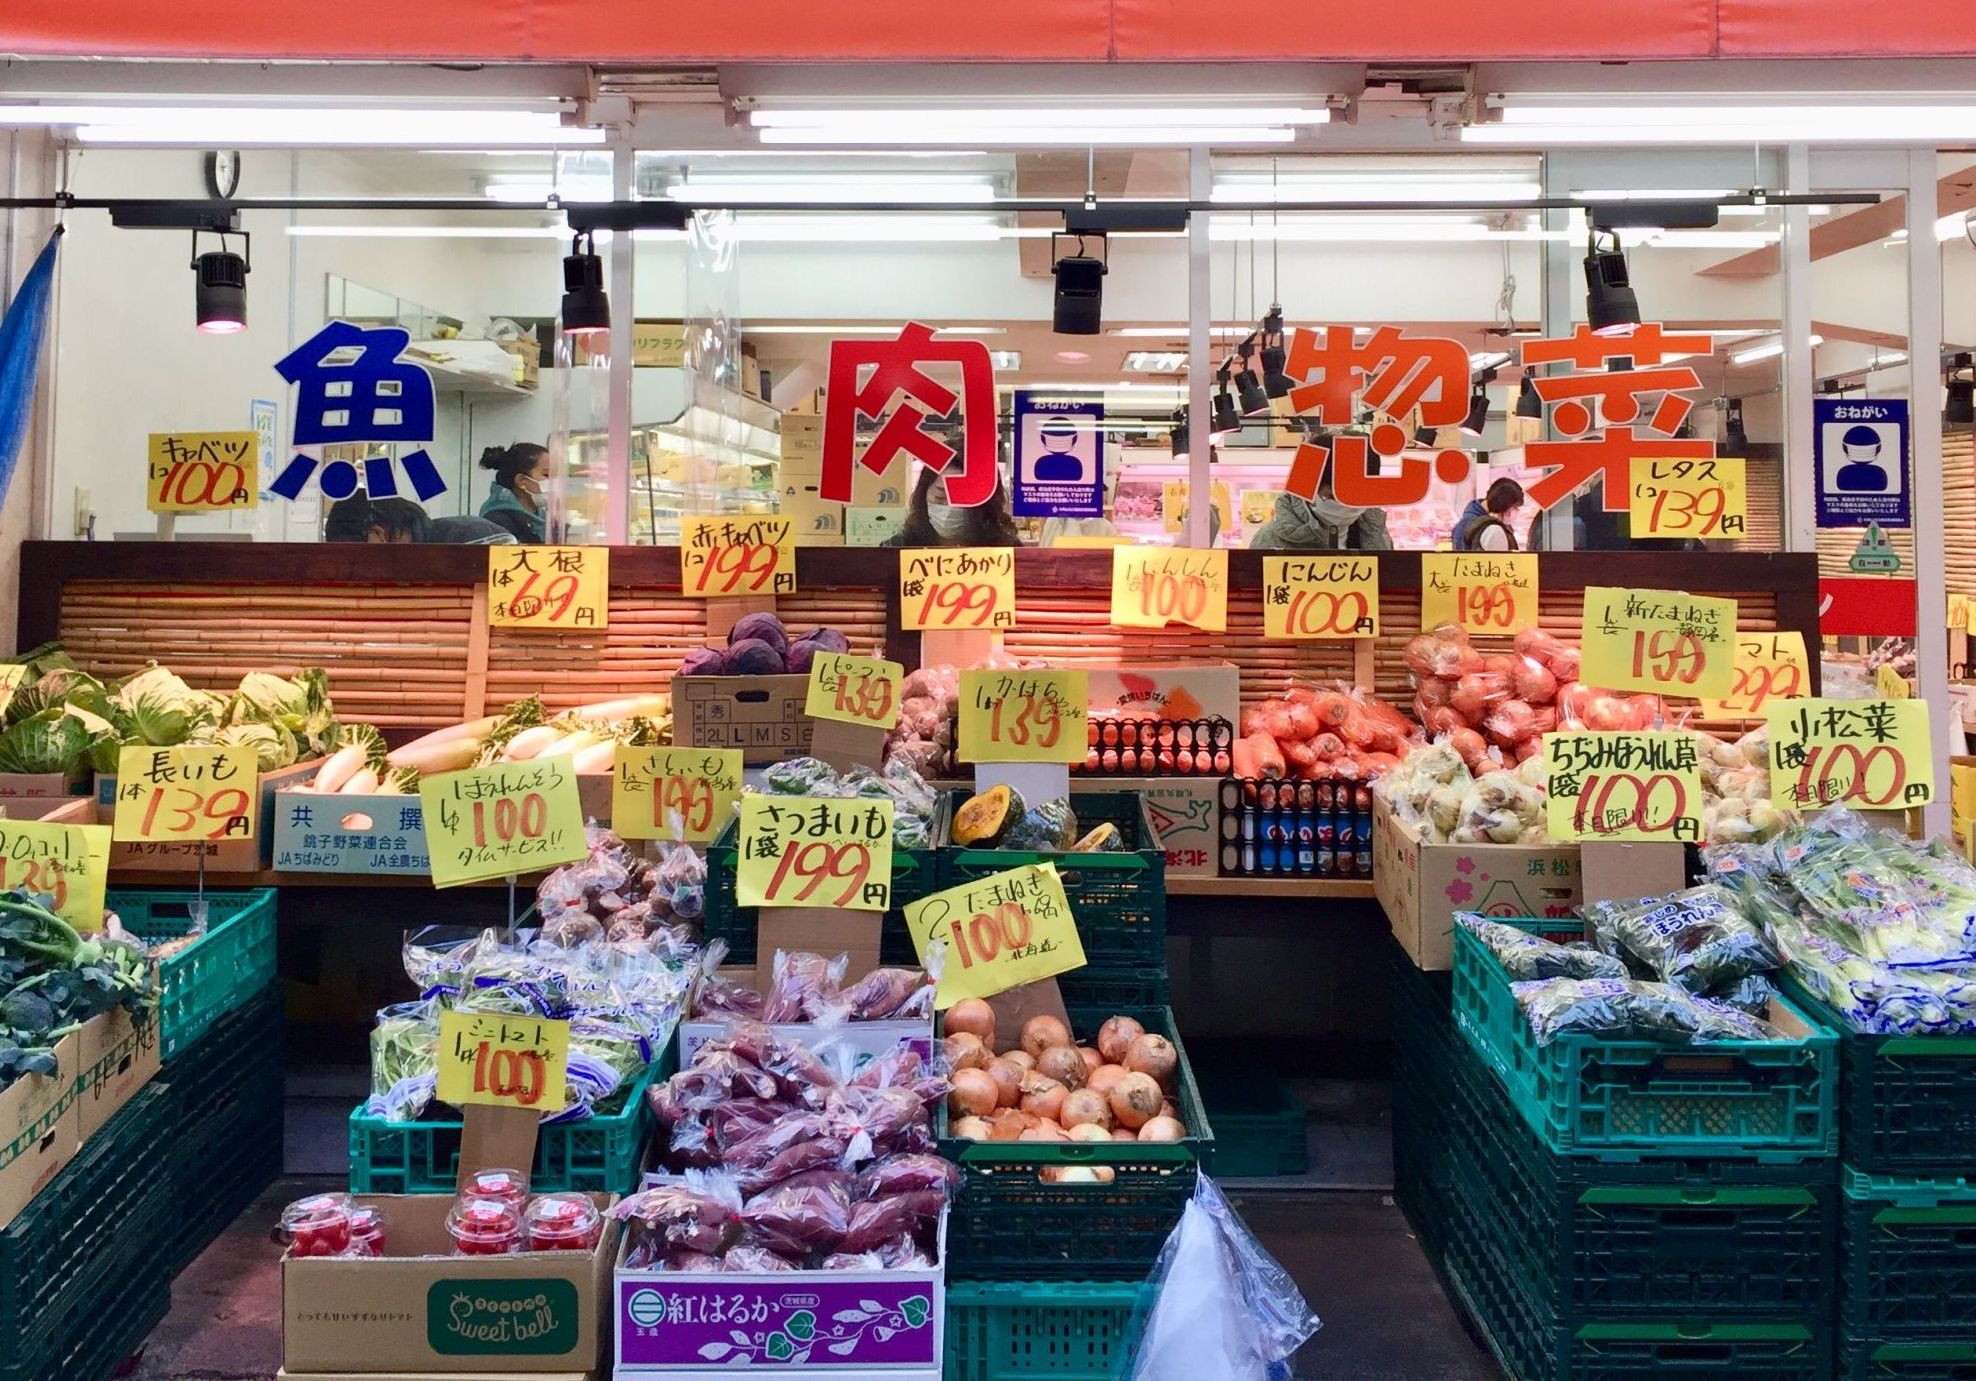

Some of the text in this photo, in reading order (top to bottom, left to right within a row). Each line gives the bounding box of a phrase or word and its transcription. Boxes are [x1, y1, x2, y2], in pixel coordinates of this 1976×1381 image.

[268, 320, 448, 502] 魚
[820, 321, 998, 507] 肉
[1283, 323, 1715, 512] 惣菜
[1834, 405, 1889, 420] おねがい
[162, 438, 249, 463] キャベツ
[1651, 461, 1720, 481] レタス
[692, 521, 790, 548] 赤キャベツ
[511, 549, 585, 574] 大根
[909, 553, 1012, 577] べにあかり
[1282, 562, 1373, 583] にんじん
[1141, 572, 1207, 621] 100
[1458, 584, 1515, 627] 199
[1738, 636, 1788, 661] マト
[834, 673, 892, 720] 139
[707, 727, 725, 743] 2L
[734, 727, 744, 743] L
[756, 727, 769, 741] M
[781, 727, 792, 741] S
[992, 697, 1061, 748] 139
[1790, 702, 1898, 743] 小松菜
[143, 751, 238, 784] 長いも
[641, 753, 724, 777] さといも
[1550, 736, 1699, 774] ちぢみほうれん草
[291, 805, 314, 829] 共
[473, 792, 548, 847] 100
[653, 774, 714, 832] 199
[756, 803, 887, 840] さつまいも
[303, 834, 408, 851] 銚子野菜連合会
[951, 902, 1032, 969] 100
[474, 1041, 546, 1105] 100
[447, 1298, 511, 1342] Sweet
[514, 1305, 560, 1341] bell
[667, 1292, 781, 1325] 紅はるか
